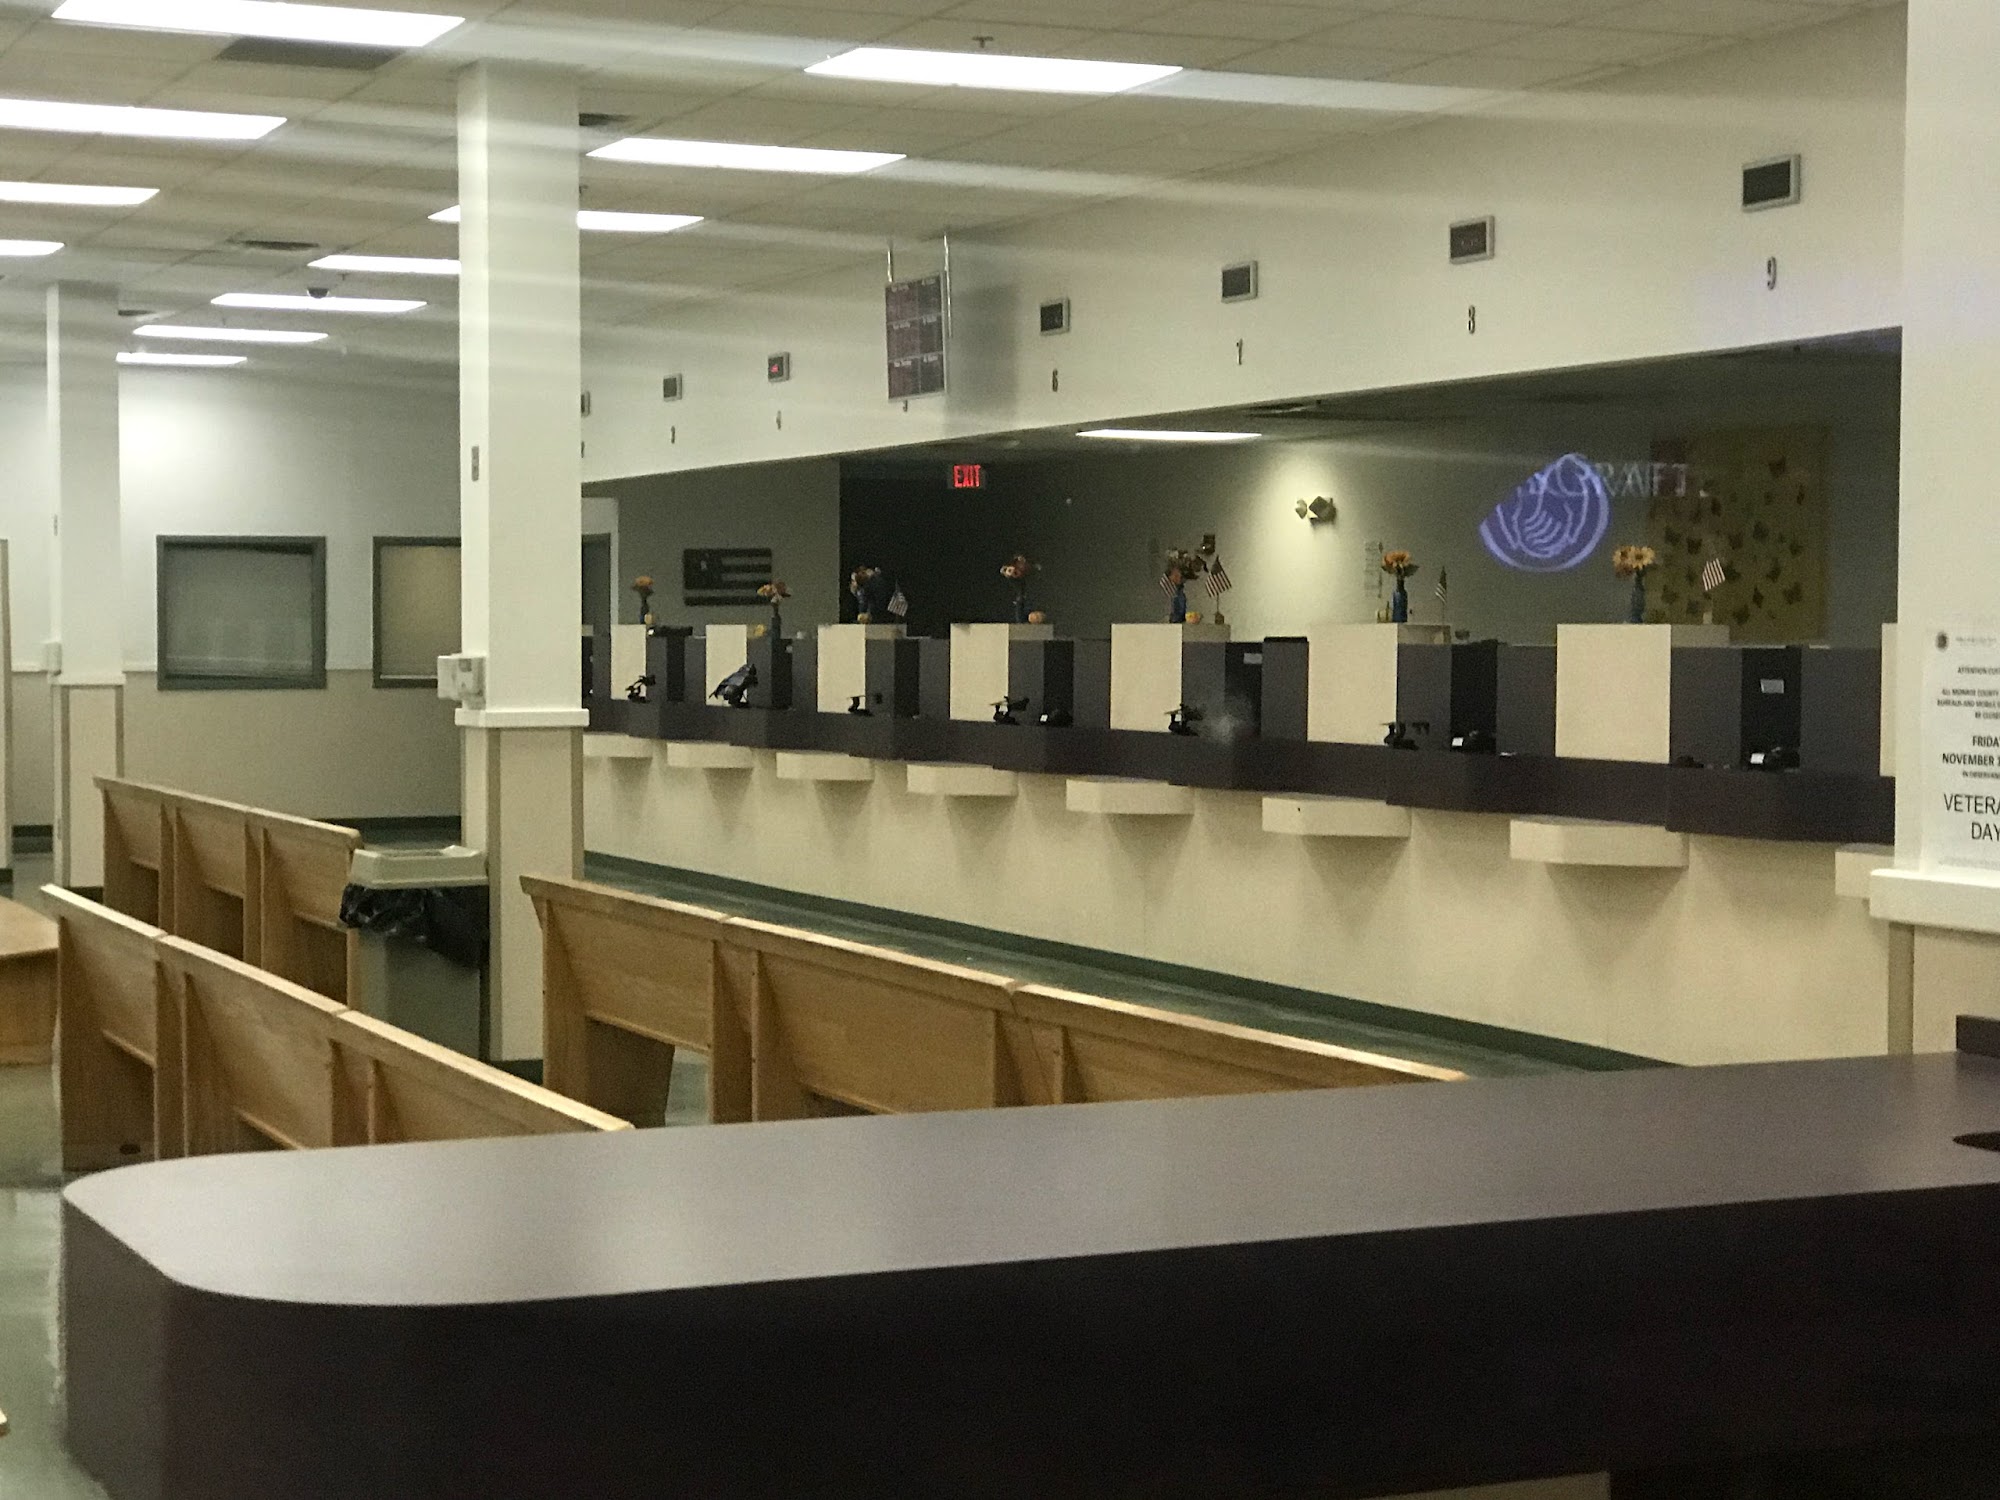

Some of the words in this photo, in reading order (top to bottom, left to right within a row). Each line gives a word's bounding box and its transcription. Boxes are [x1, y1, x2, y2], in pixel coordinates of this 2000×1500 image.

[1767, 256, 1777, 290] 9
[1468, 305, 1476, 335] 8
[953, 465, 981, 487] EXIT
[1977, 689, 1999, 698] COUNTY
[1942, 753, 1995, 767] NOVEMBER
[1971, 822, 2000, 842] DAY
